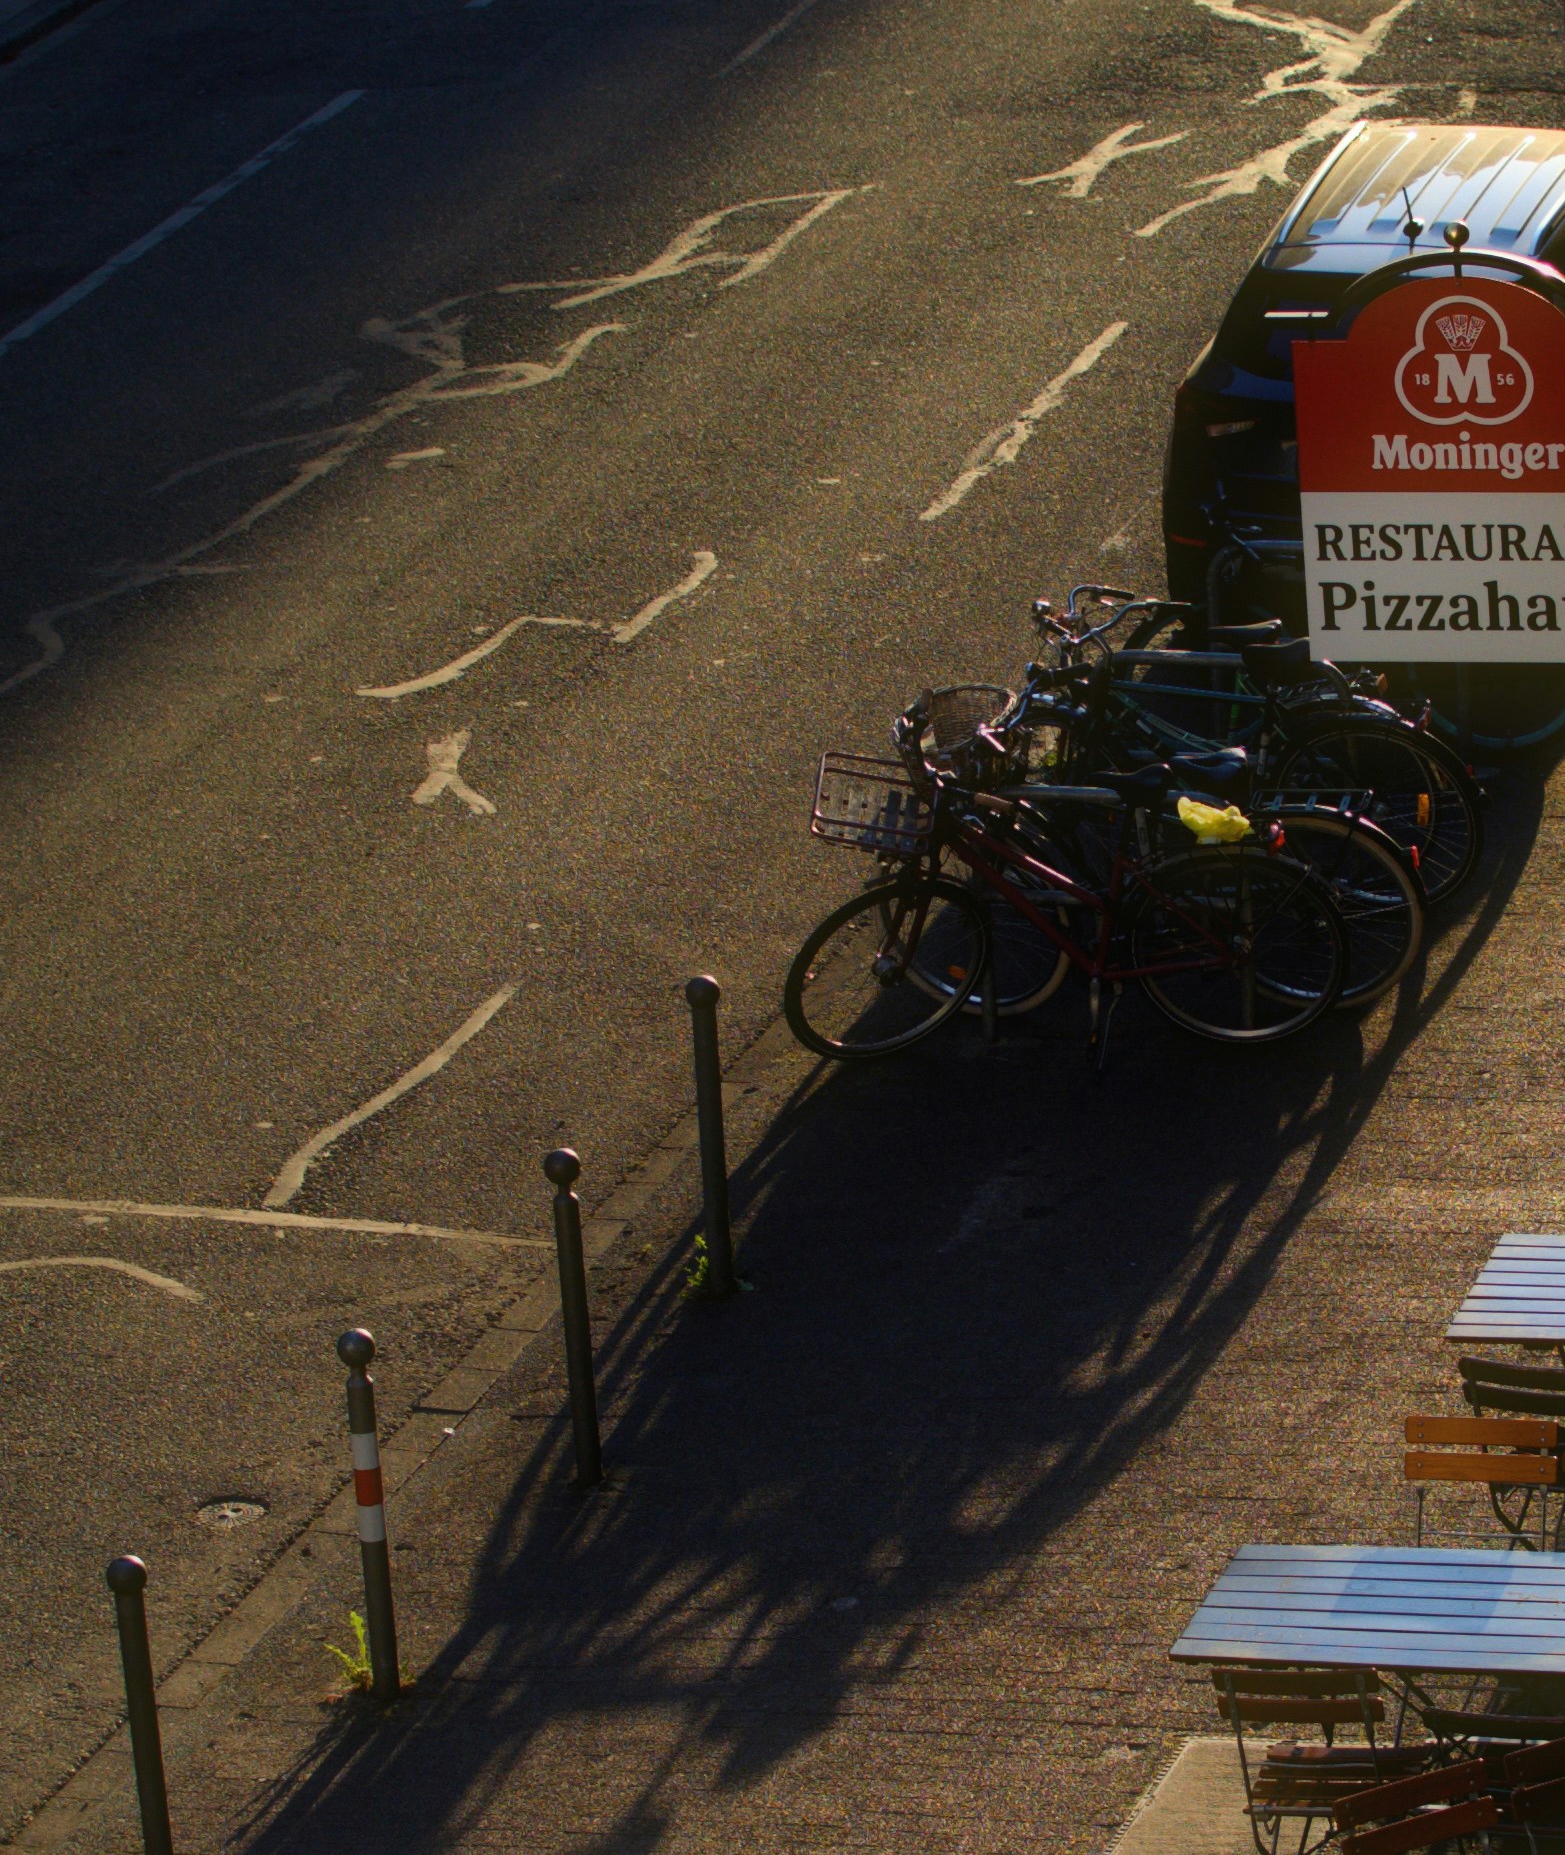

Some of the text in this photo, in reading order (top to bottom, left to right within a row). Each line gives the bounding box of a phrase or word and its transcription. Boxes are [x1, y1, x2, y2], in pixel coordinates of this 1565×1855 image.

[1414, 353, 1515, 404] 18 M 56
[1371, 431, 1565, 479] Moninger
